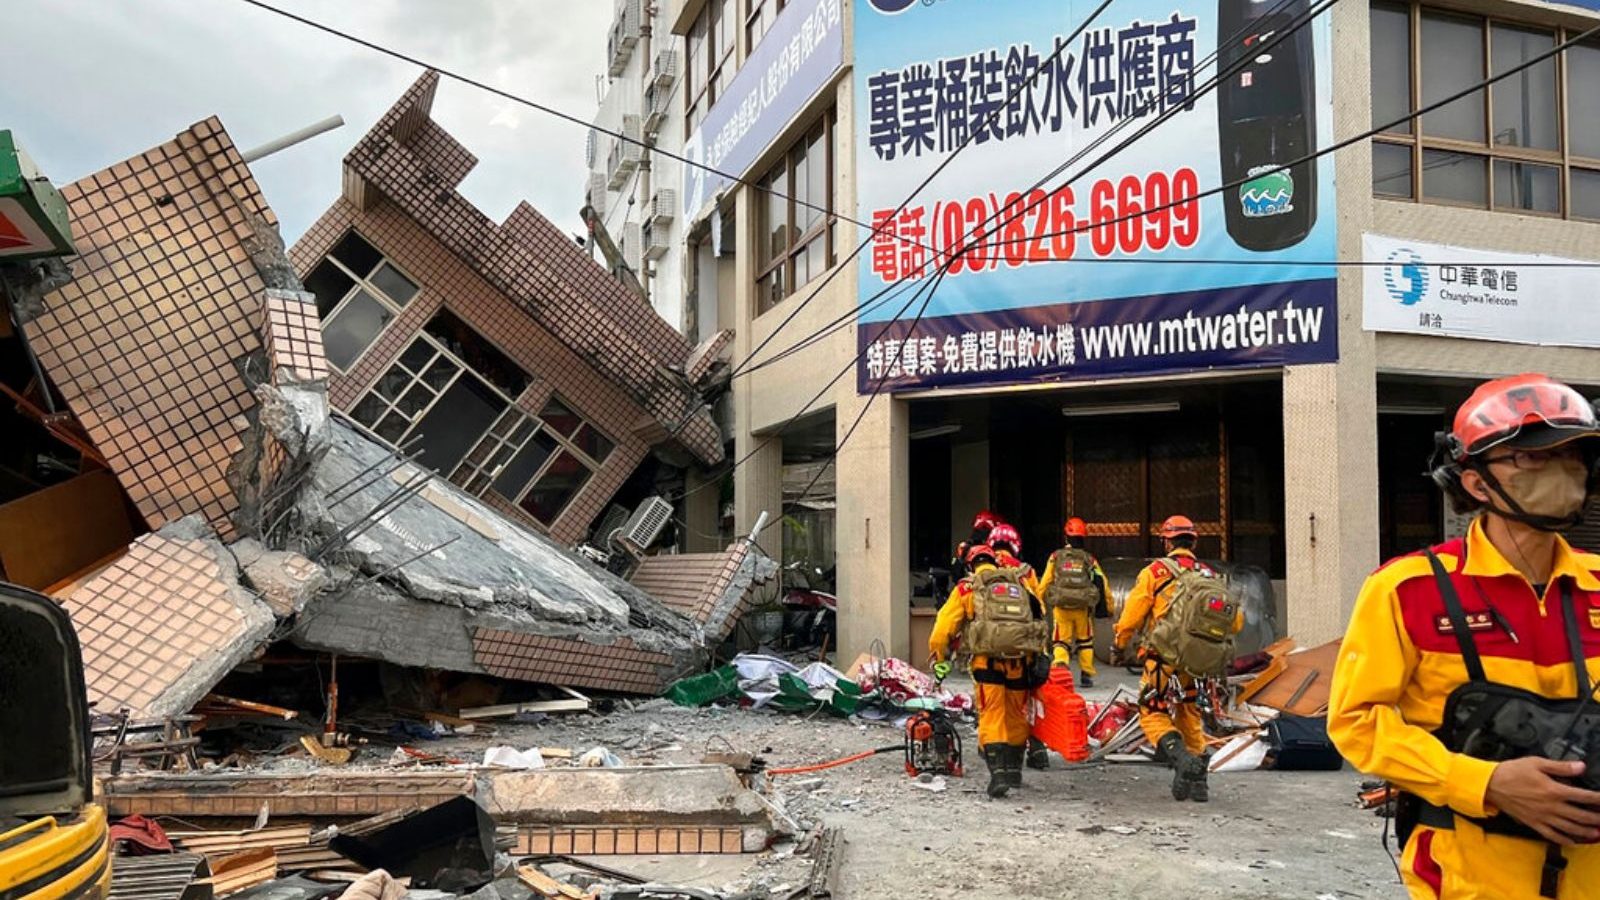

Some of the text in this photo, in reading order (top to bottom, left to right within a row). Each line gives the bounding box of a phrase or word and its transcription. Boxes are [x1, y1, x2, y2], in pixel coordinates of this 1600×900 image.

[706, 0, 840, 178] 保險經紀人股份有限公司
[868, 15, 1197, 160] 專業桶裝飲水供應商
[1440, 264, 1518, 291] 中華電信
[1081, 300, 1323, 360] www.mtwater.tw
